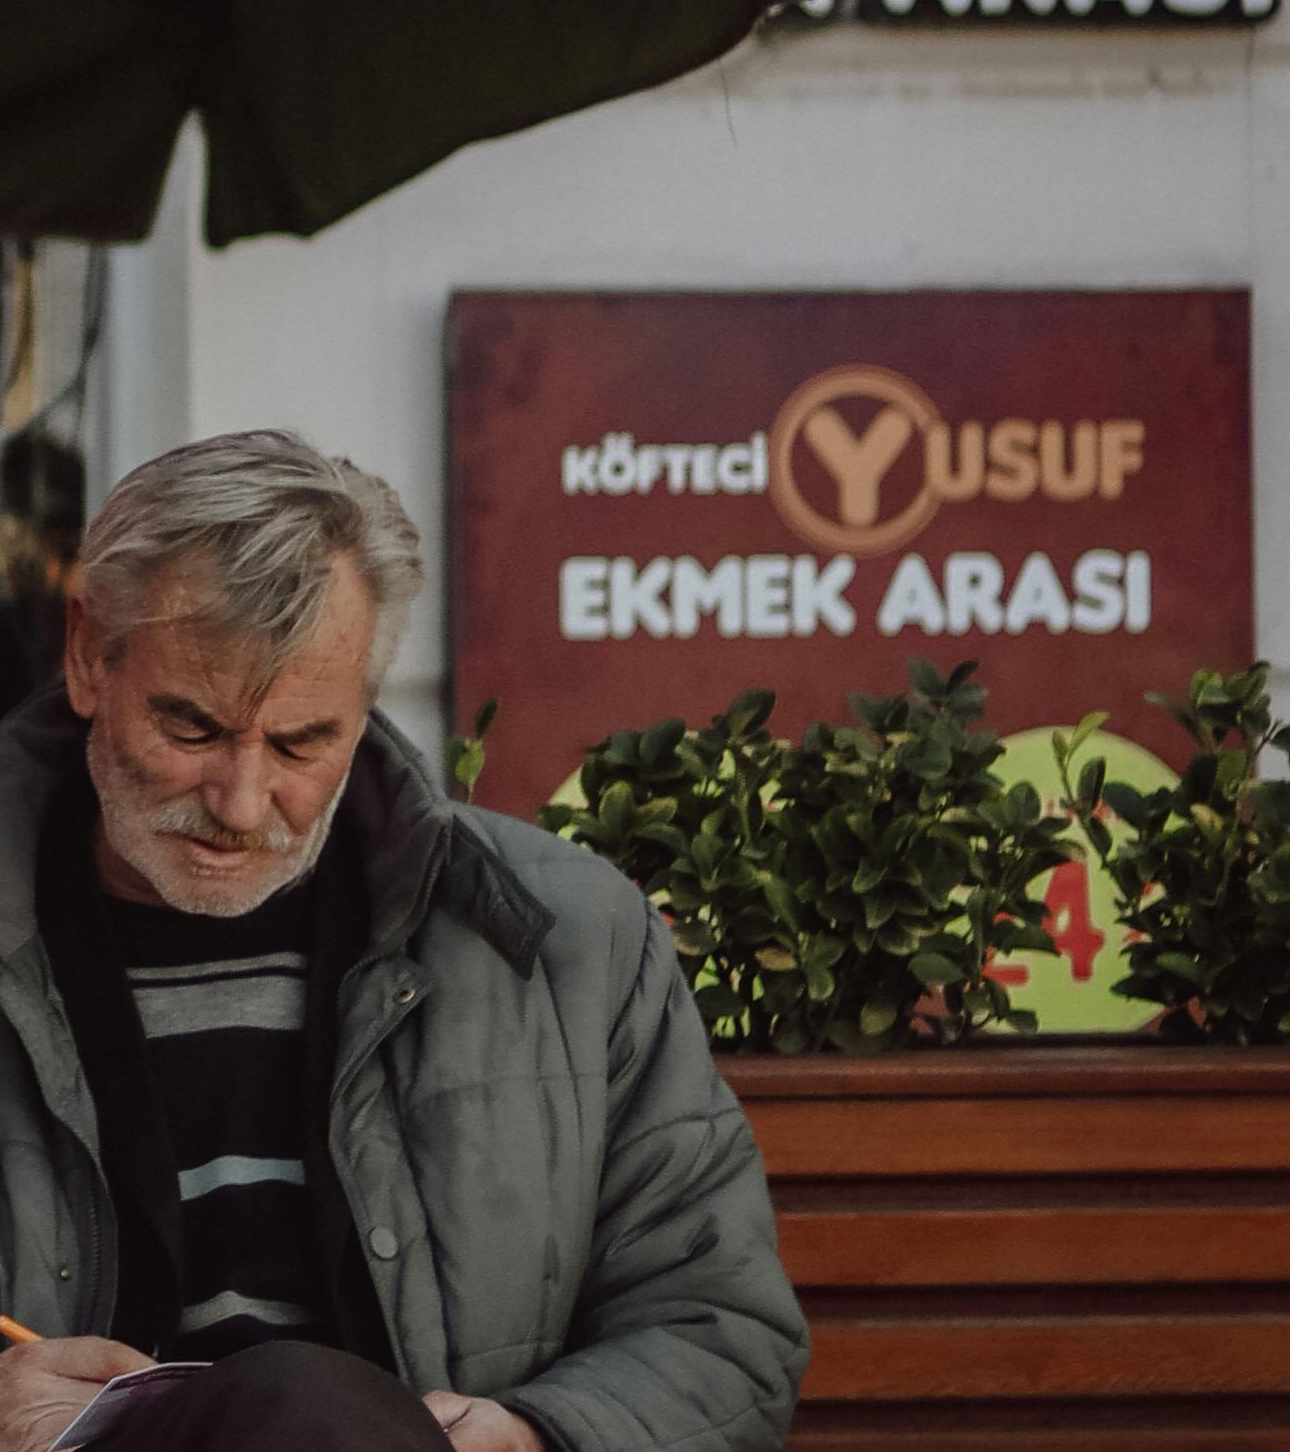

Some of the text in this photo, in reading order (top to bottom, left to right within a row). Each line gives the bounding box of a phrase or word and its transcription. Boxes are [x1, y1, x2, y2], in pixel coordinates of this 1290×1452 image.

[804, 406, 1145, 528] YUSUF
[559, 551, 1152, 640] EKMEK ARASI
